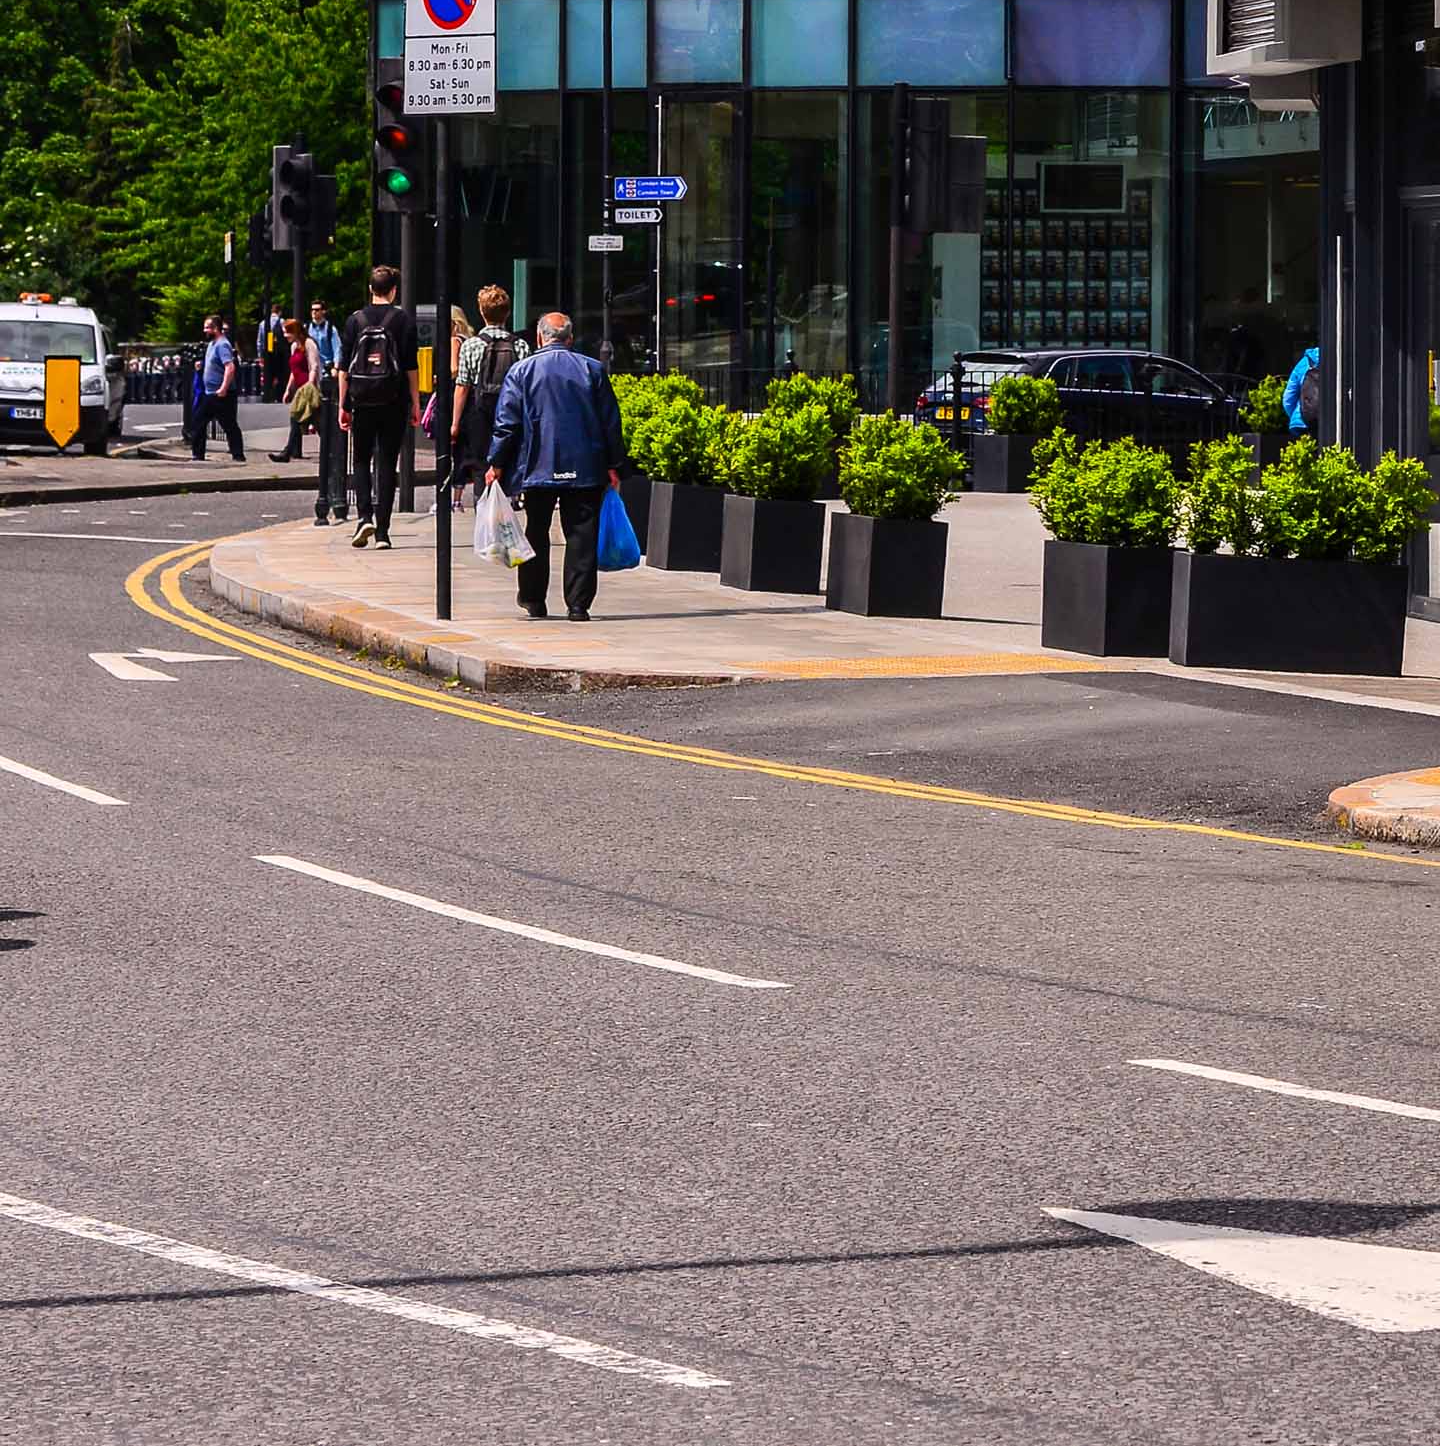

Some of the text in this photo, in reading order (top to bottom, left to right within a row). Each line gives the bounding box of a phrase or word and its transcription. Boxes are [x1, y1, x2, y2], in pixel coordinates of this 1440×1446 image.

[408, 60, 431, 71] 8.30
[476, 60, 491, 71] pm
[408, 94, 431, 106] 9.30
[476, 95, 491, 106] pm
[617, 211, 652, 219] TOILET
